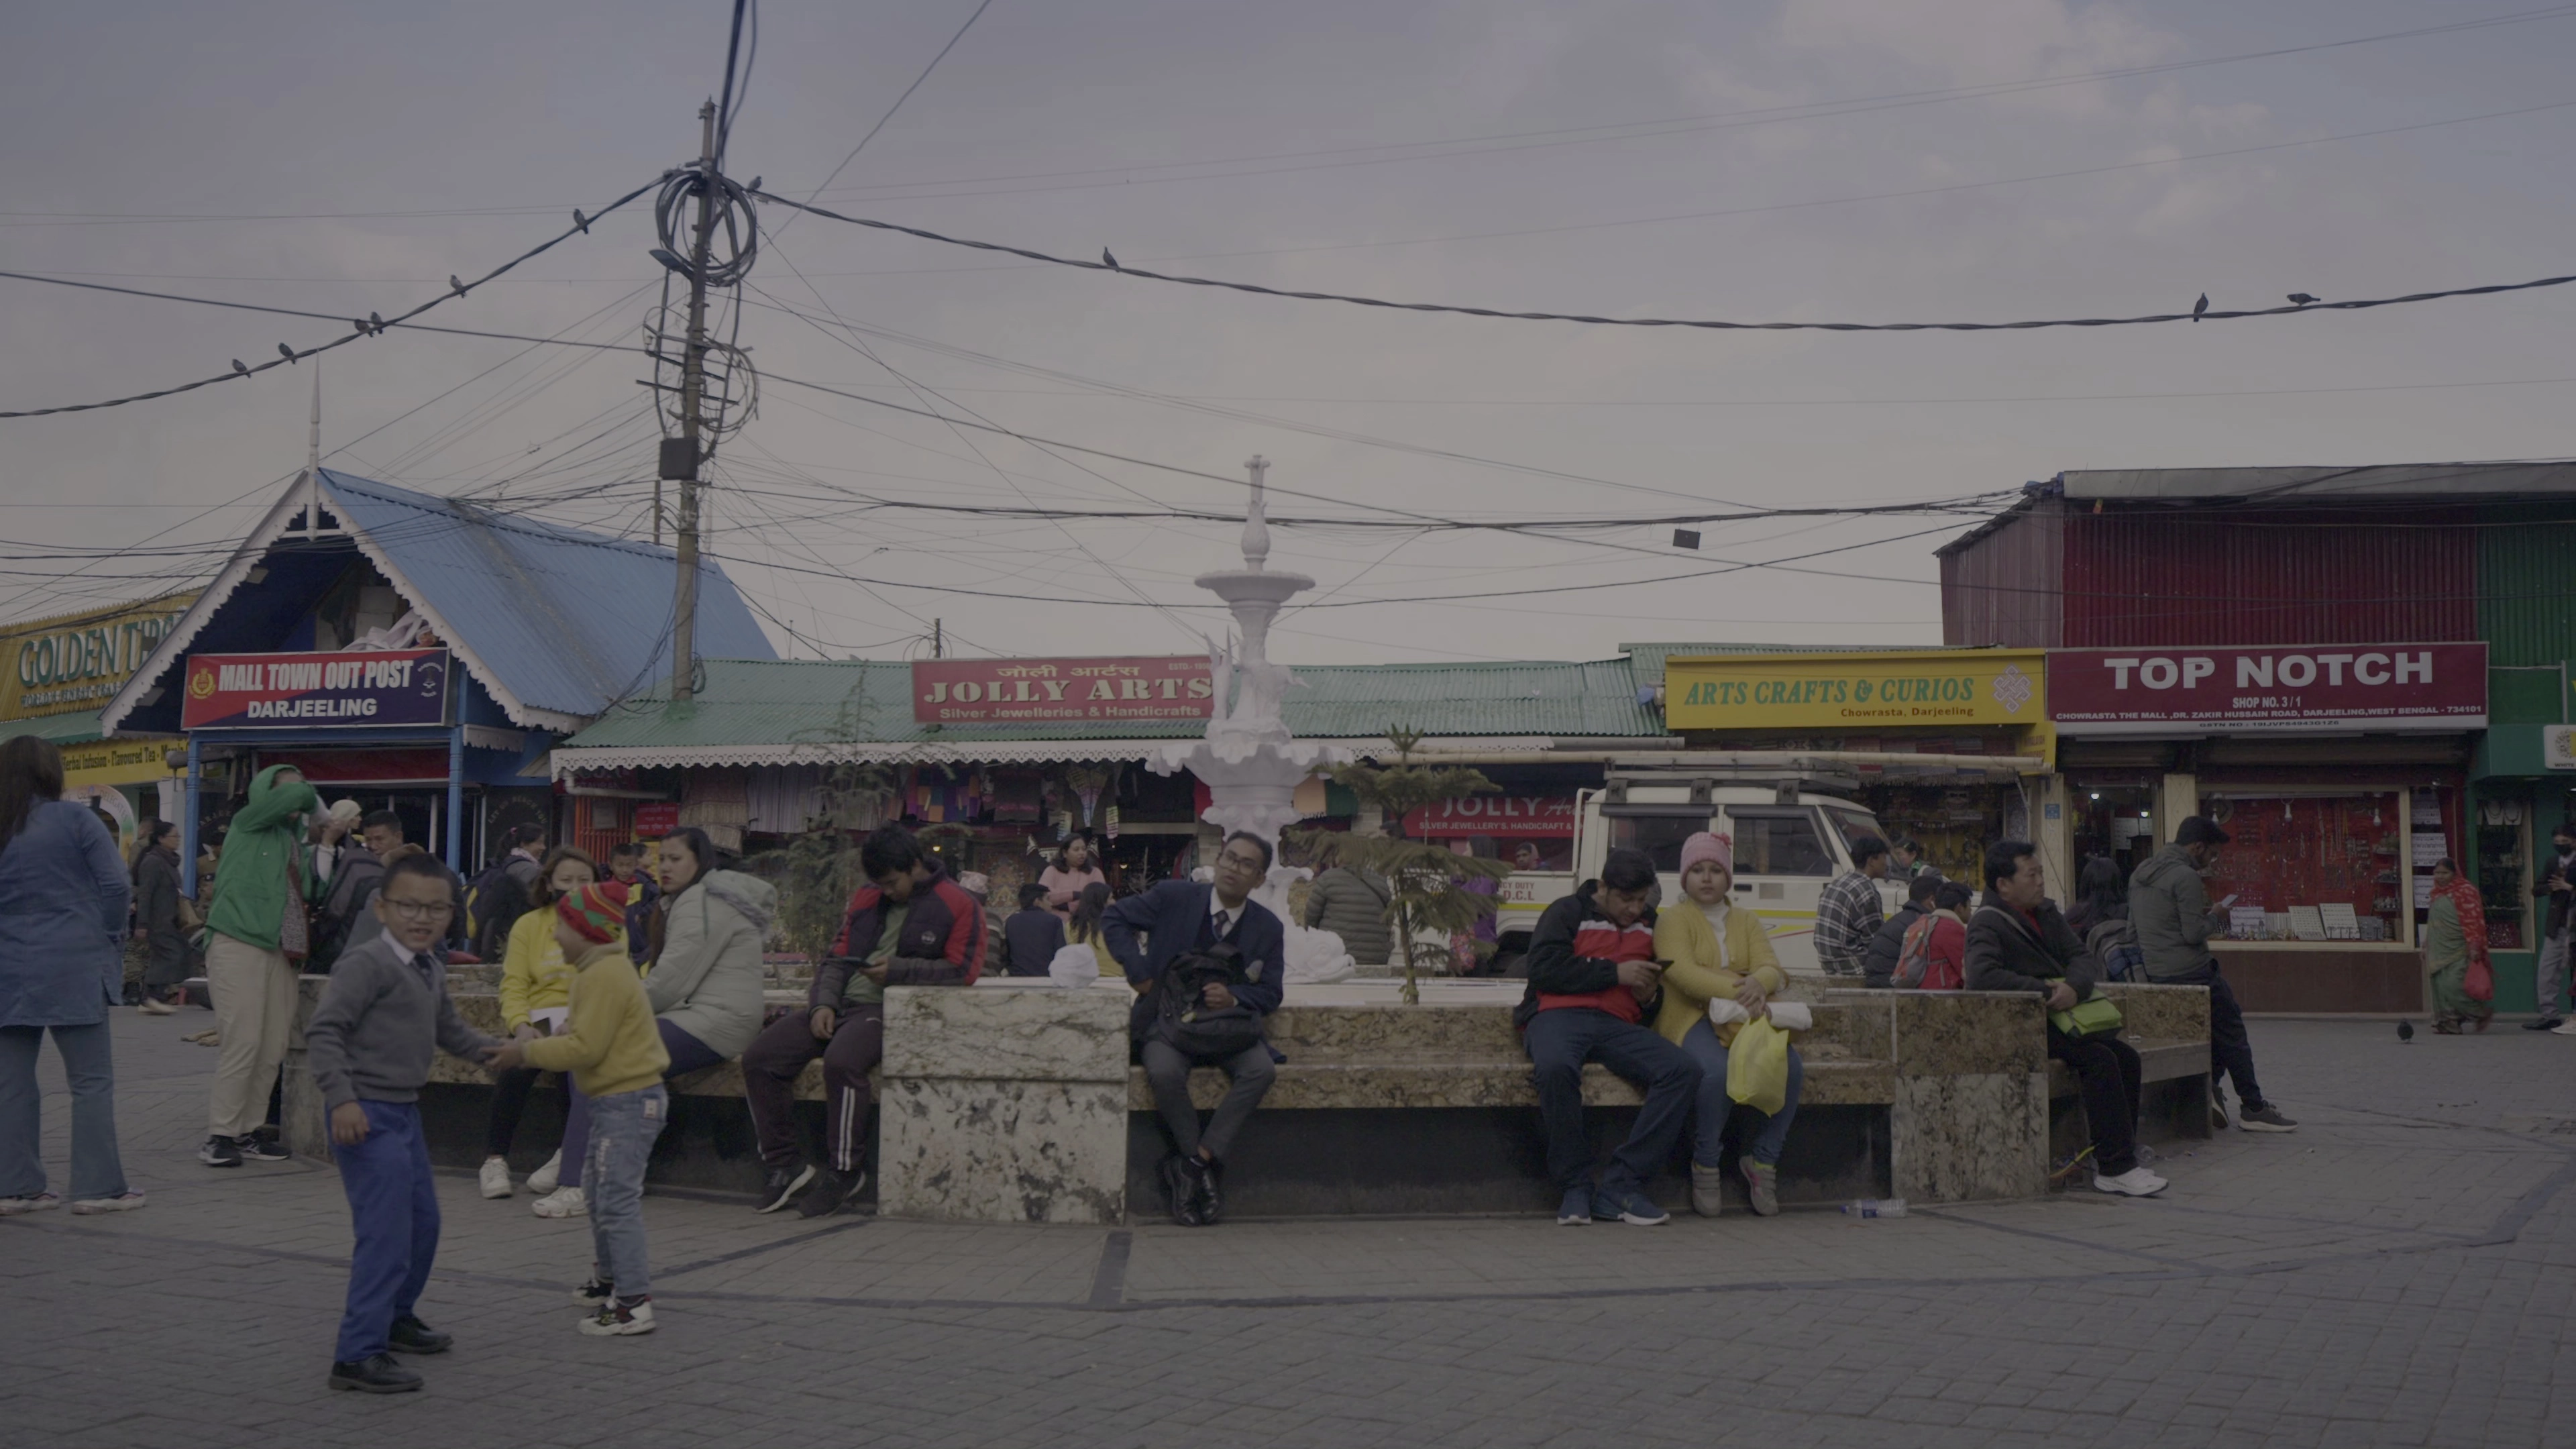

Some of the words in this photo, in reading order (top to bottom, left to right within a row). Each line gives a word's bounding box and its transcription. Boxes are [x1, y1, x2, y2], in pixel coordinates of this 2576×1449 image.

[18, 625, 125, 687] GOLDEN
[217, 663, 264, 692] MALL
[268, 661, 321, 691] TOWN
[325, 661, 364, 690] OUT
[364, 659, 415, 689] POST
[2104, 656, 2216, 690] TOP
[2237, 652, 2432, 687] NOTCH
[923, 680, 1071, 704] JOLLY
[1086, 678, 1214, 701] ARTS
[1684, 682, 1748, 706] ARTS
[1754, 679, 1847, 705] CRAFTS
[1854, 678, 1874, 703] &
[1880, 677, 1975, 702] CURIOS
[247, 698, 378, 719] DARJEELING
[939, 708, 987, 719] Silver
[991, 707, 1083, 718] Jewelleries
[1088, 706, 1101, 717] &
[1106, 706, 1201, 717] Handicrafts
[1841, 708, 1907, 718] Chowrasta,
[1911, 707, 1974, 718] Darjeeling
[2056, 712, 2116, 720] CHOWRASTA
[2224, 710, 2268, 718] HUSSAIN
[2271, 709, 2300, 718] ROAD,
[2398, 706, 2438, 714] BENGAL
[2447, 705, 2481, 713] 734101
[2233, 697, 2260, 708] SHOP
[2262, 696, 2279, 708] NO.
[83, 752, 107, 770] Infusion
[111, 747, 143, 767] Flavoured
[144, 745, 156, 763] Tea
[1442, 797, 1544, 818] JOLLY
[1511, 822, 1564, 830] HANDICRAFT
[1566, 822, 1572, 830] &
[1515, 881, 1535, 890] DUTY
